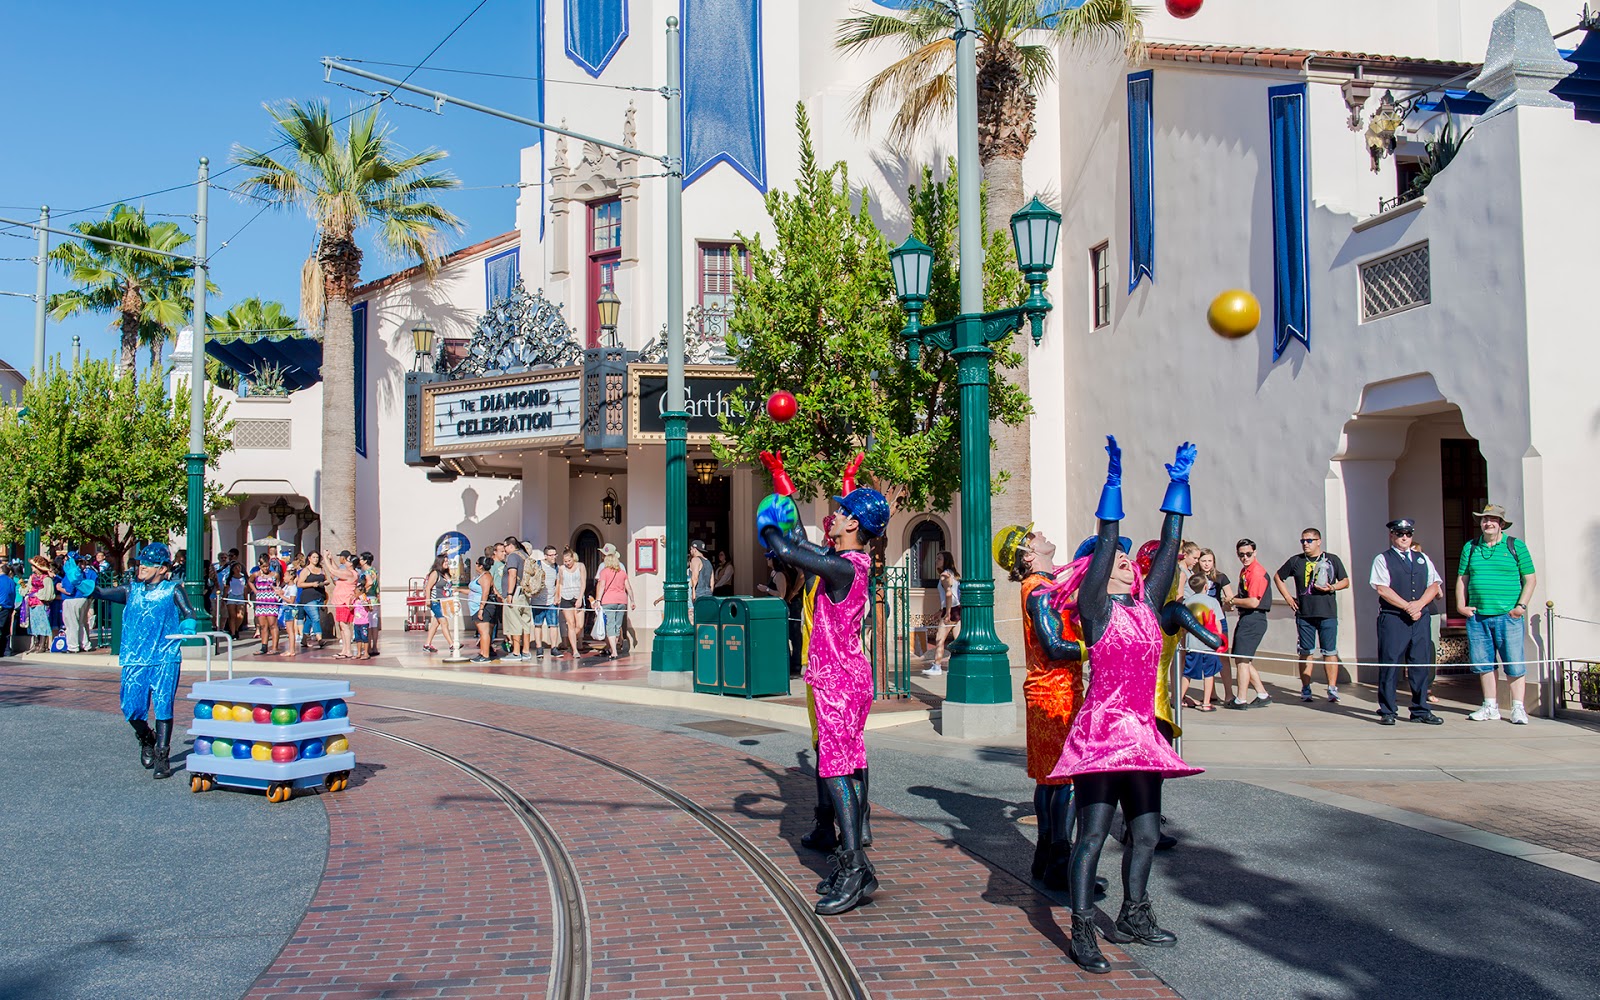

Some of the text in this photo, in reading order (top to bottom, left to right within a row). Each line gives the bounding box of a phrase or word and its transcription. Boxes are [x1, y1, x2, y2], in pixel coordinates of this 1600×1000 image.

[480, 388, 551, 411] DIAMOND
[658, 386, 755, 426] Carthy
[456, 411, 553, 436] CELEBRATION
